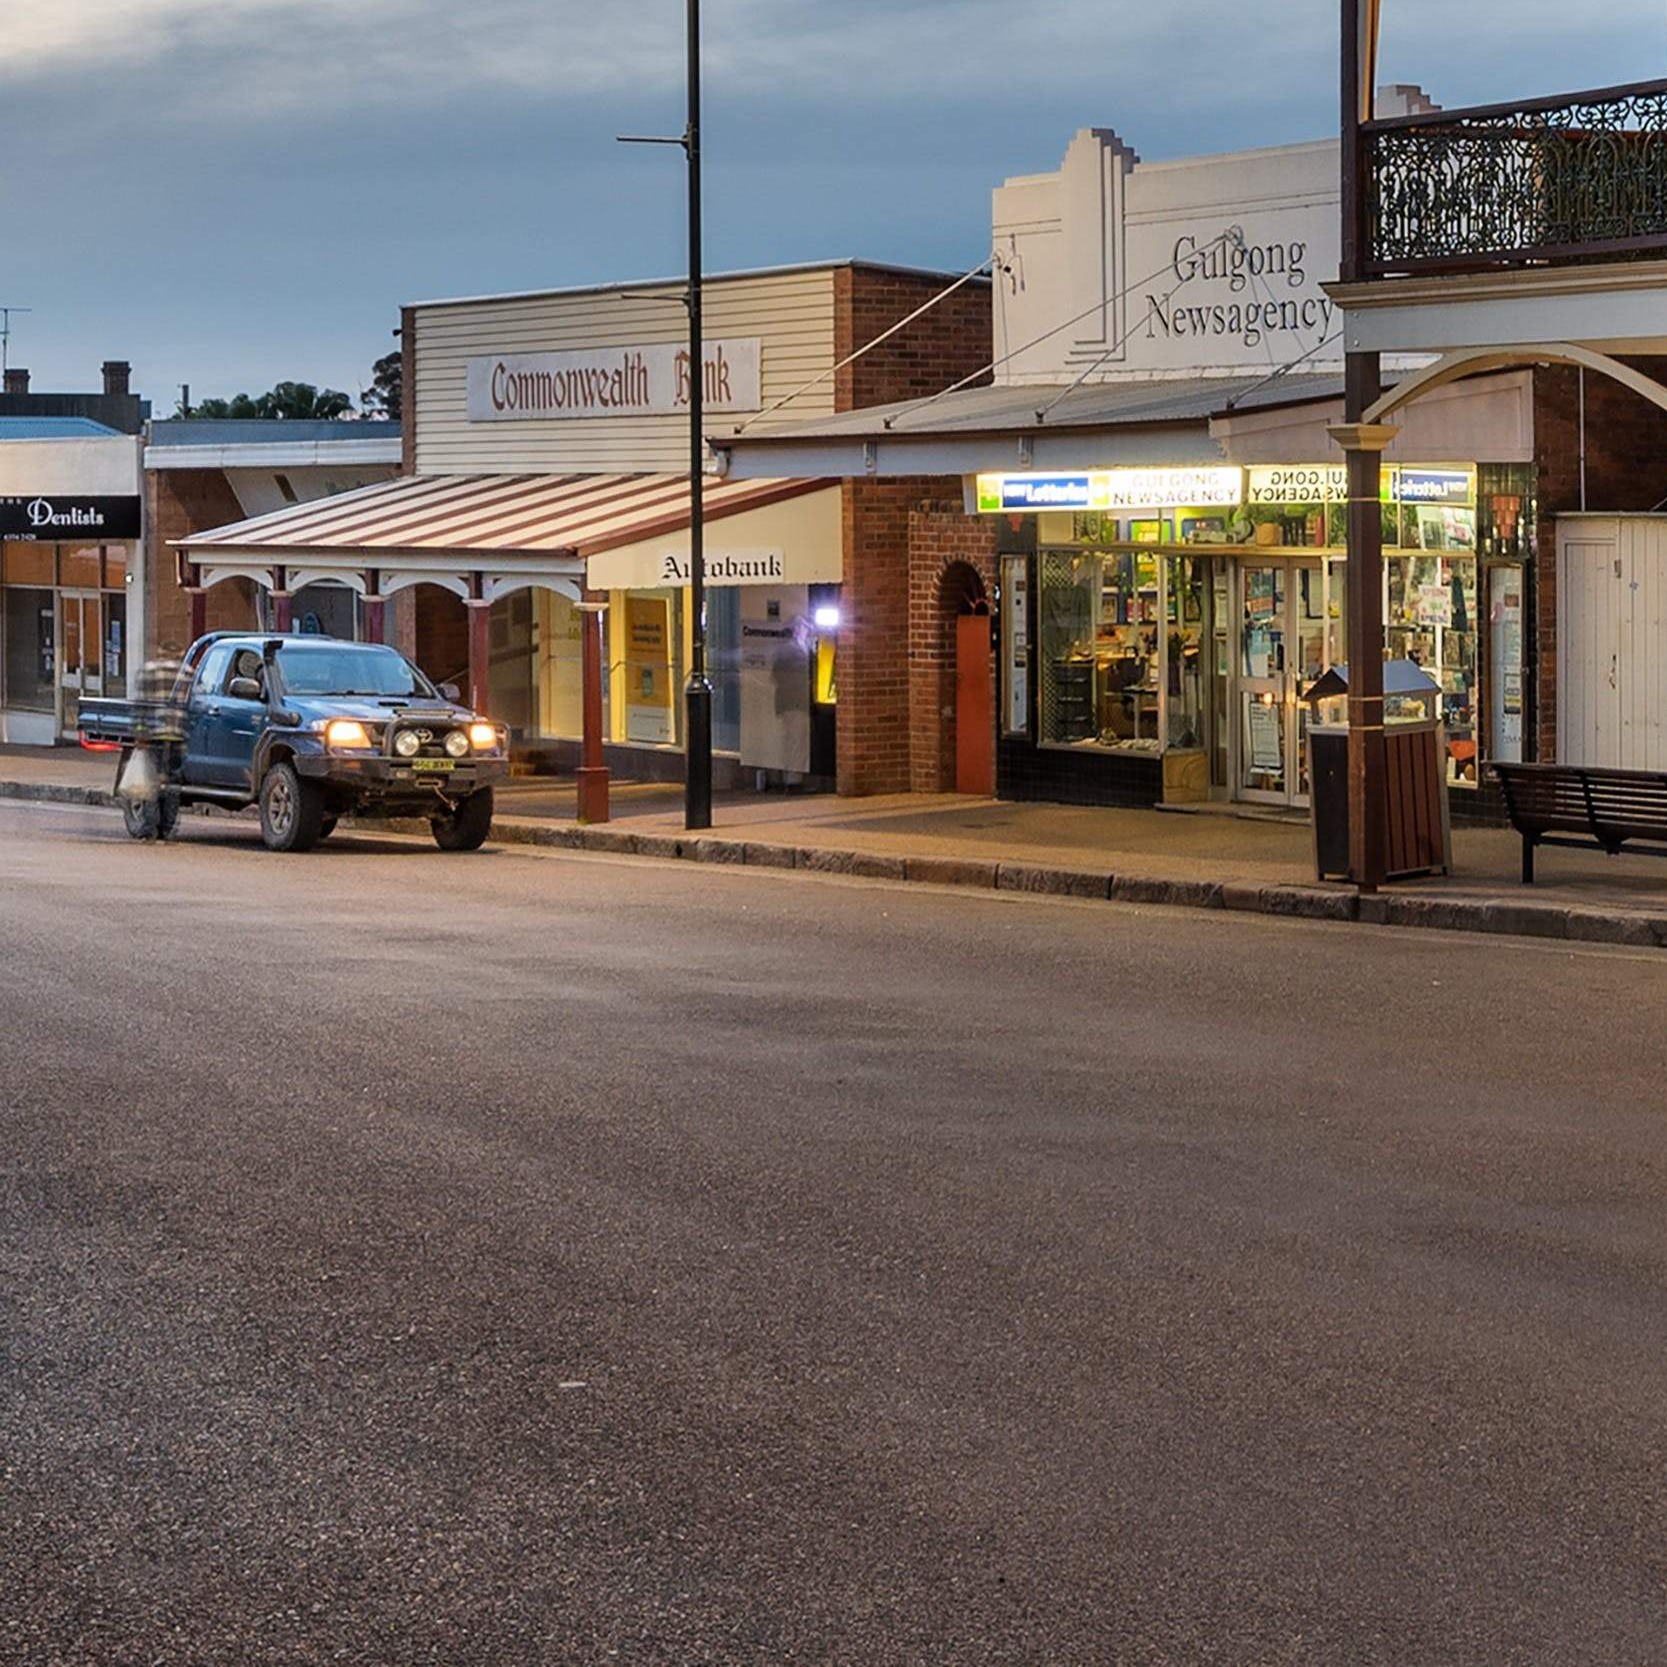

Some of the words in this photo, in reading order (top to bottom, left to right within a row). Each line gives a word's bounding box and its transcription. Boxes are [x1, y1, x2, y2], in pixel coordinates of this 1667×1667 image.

[1174, 236, 1306, 292] Gulgong
[1146, 293, 1334, 347] Newsagency
[490, 350, 650, 411] Commonwealth
[673, 344, 732, 406] Bnk
[27, 497, 104, 526] Dentists
[1113, 487, 1237, 505] NEWSAGENCY
